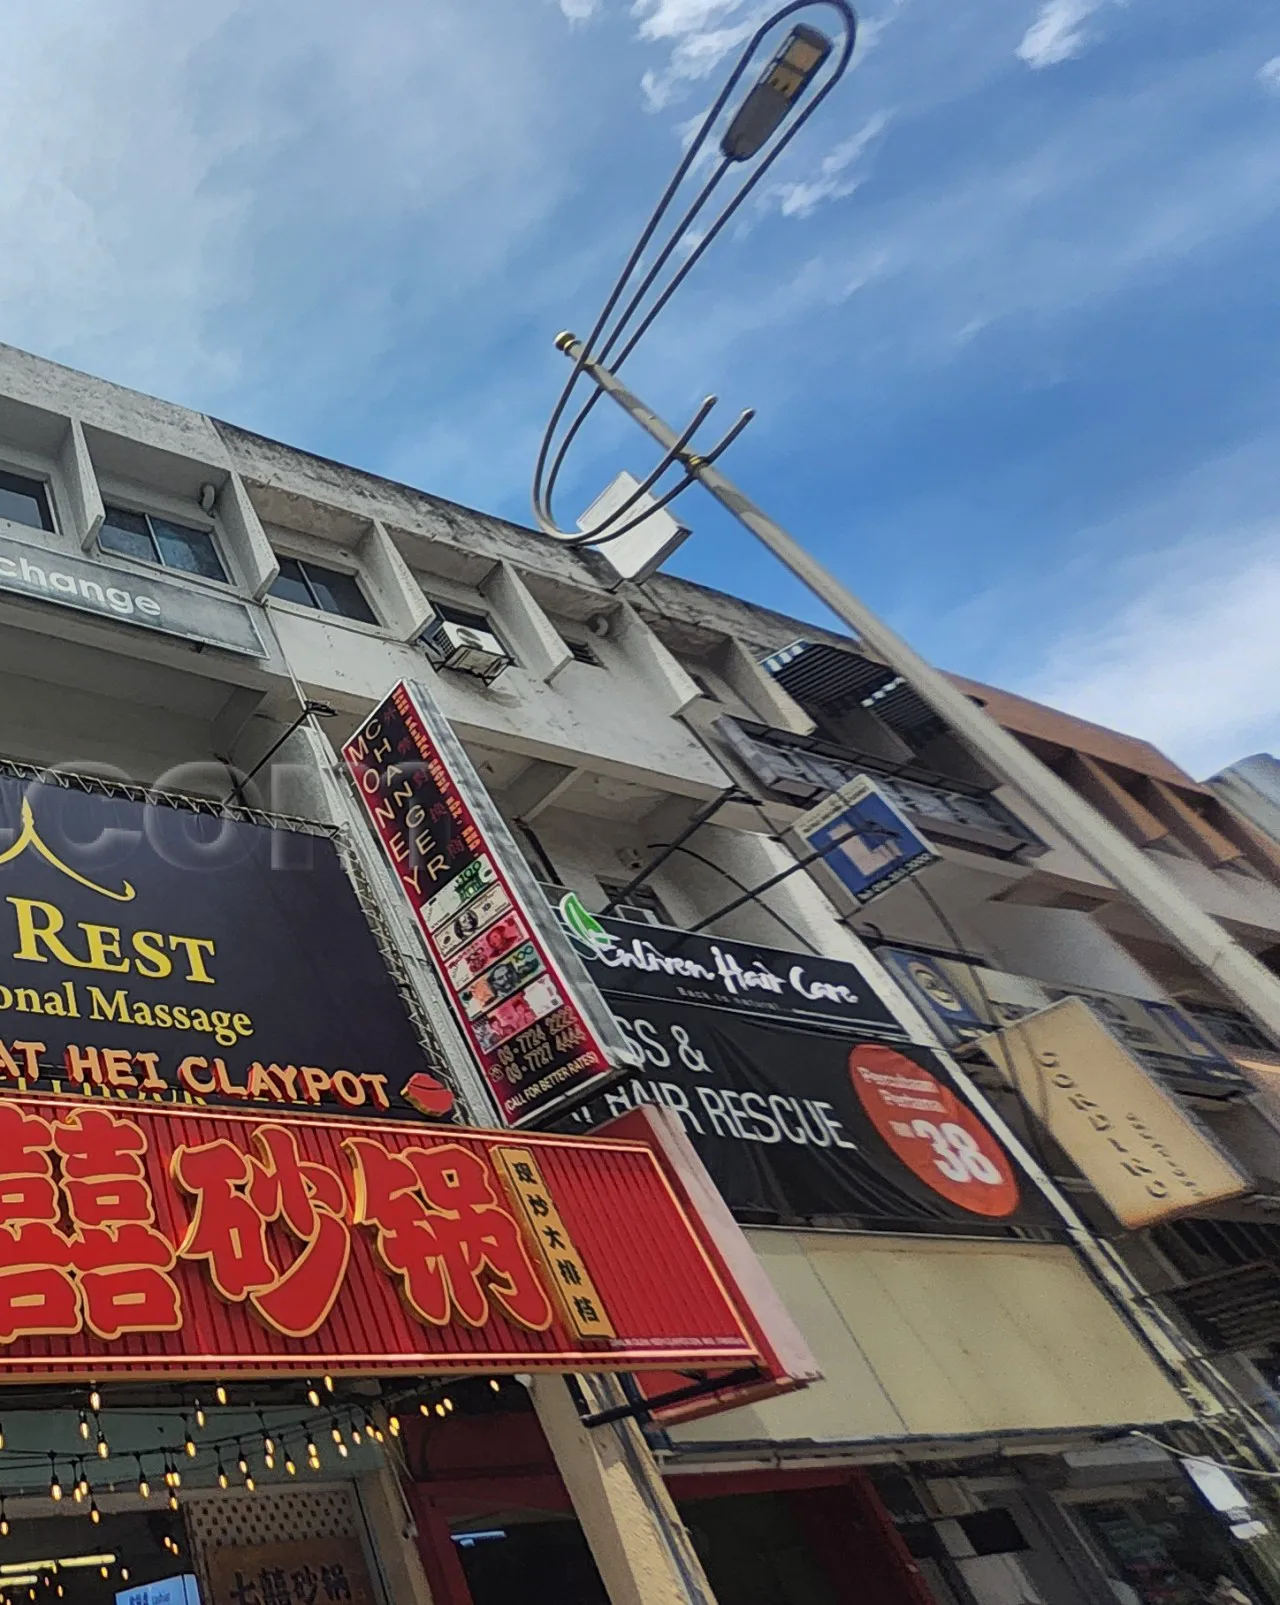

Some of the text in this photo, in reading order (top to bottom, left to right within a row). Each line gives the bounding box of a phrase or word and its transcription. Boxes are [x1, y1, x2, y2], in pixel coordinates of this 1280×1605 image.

[347, 735, 423, 895] MONEY
[365, 718, 451, 882] CHANGER
[710, 945, 787, 994] Hair
[789, 966, 859, 1004] Care
[88, 986, 255, 1047] Massage
[64, 1044, 168, 1092] HEI
[177, 1056, 391, 1112] CLAYPOT
[671, 1025, 713, 1074] &
[504, 1050, 600, 1115] (CALL FOR BETTER RATES)
[696, 1086, 859, 1150] RESCUE
[910, 1119, 1004, 1185] 38
